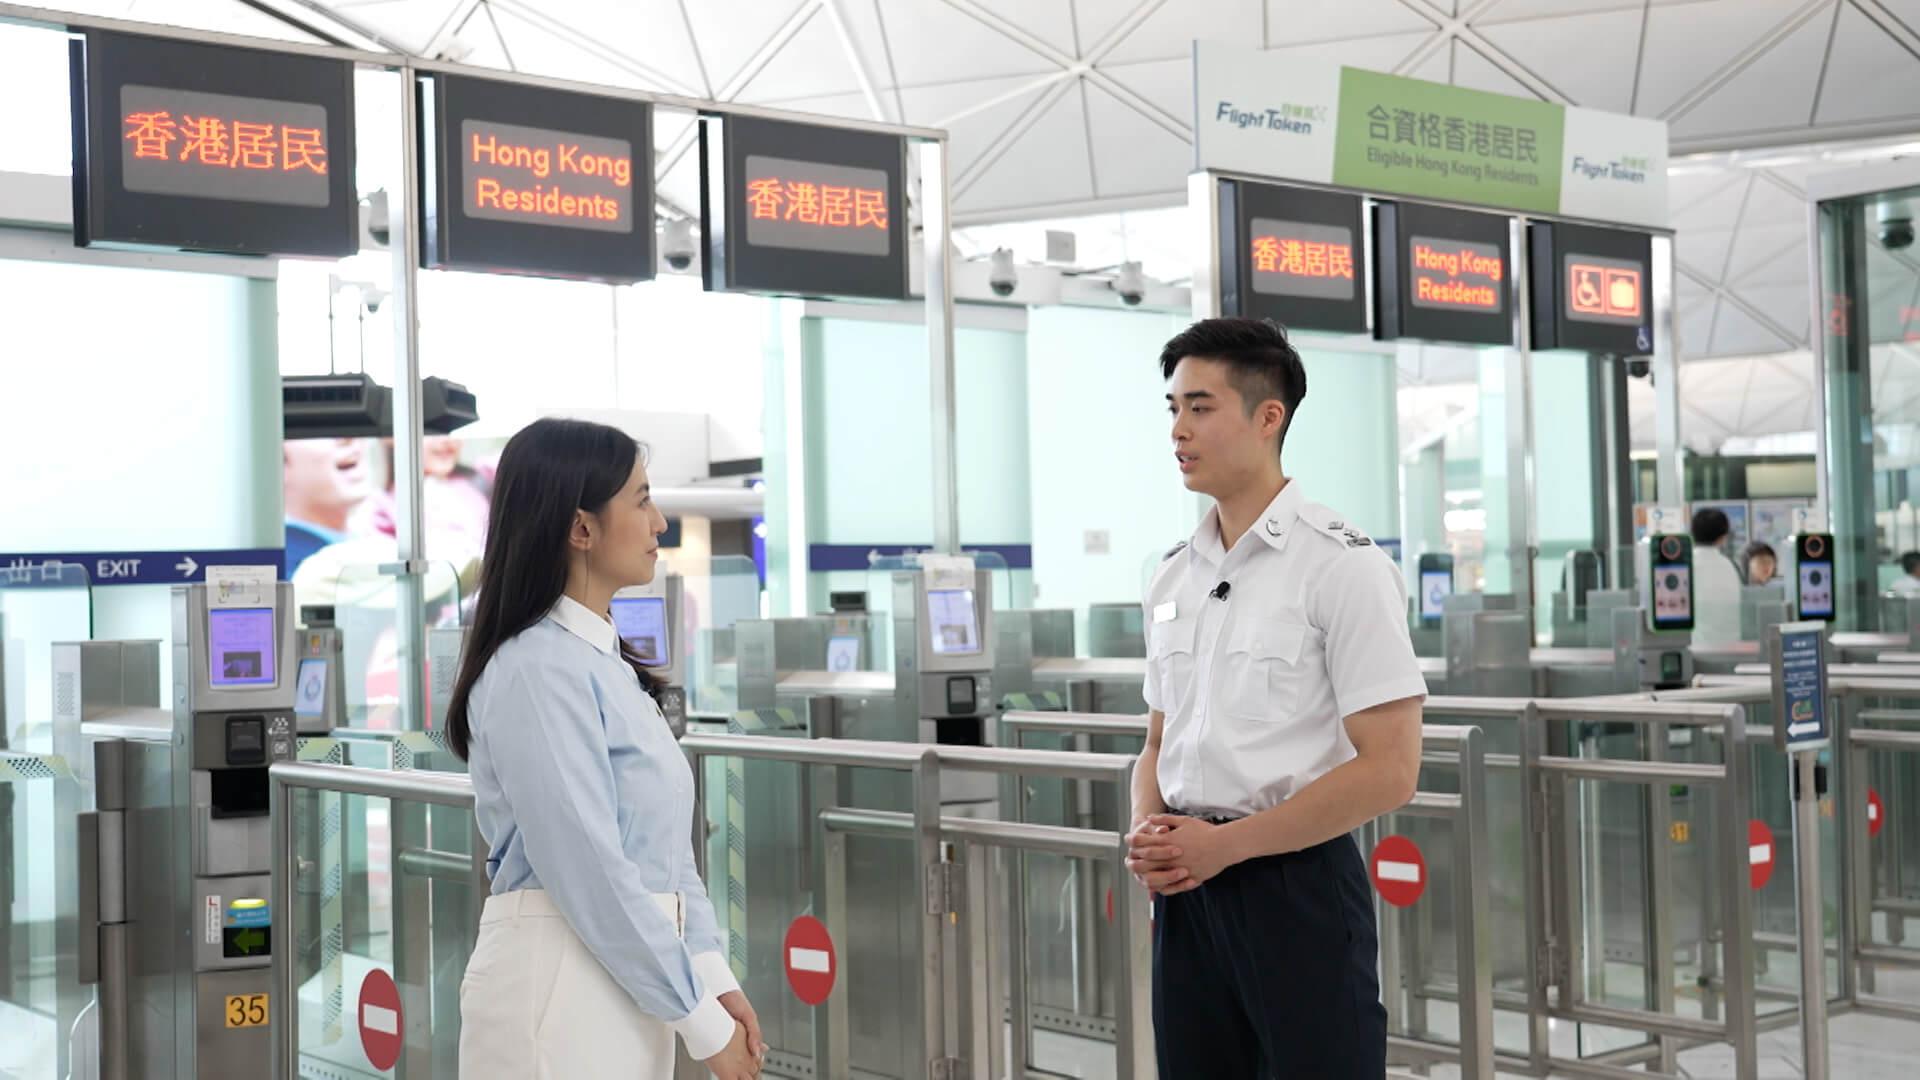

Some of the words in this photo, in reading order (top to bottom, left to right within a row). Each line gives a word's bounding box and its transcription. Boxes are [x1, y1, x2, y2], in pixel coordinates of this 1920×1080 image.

[125, 111, 327, 175] 香港居民
[1366, 104, 1538, 163] 合資格香港居民
[472, 133, 550, 177] Hong
[558, 143, 631, 187] Kong
[1367, 147, 1412, 168] Eligible
[1415, 154, 1449, 177] Hong
[1452, 161, 1481, 181] Kong
[1484, 164, 1538, 186] Residents
[477, 177, 618, 220] Residents
[747, 178, 887, 230] 香港居民
[1252, 236, 1353, 279] 香港居民
[1415, 245, 1457, 275] Hong
[1461, 249, 1502, 281] Kong
[1418, 276, 1495, 306] Residents
[8, 556, 62, 584] 出口
[97, 559, 142, 578] EXIT
[229, 996, 265, 1026] 35
